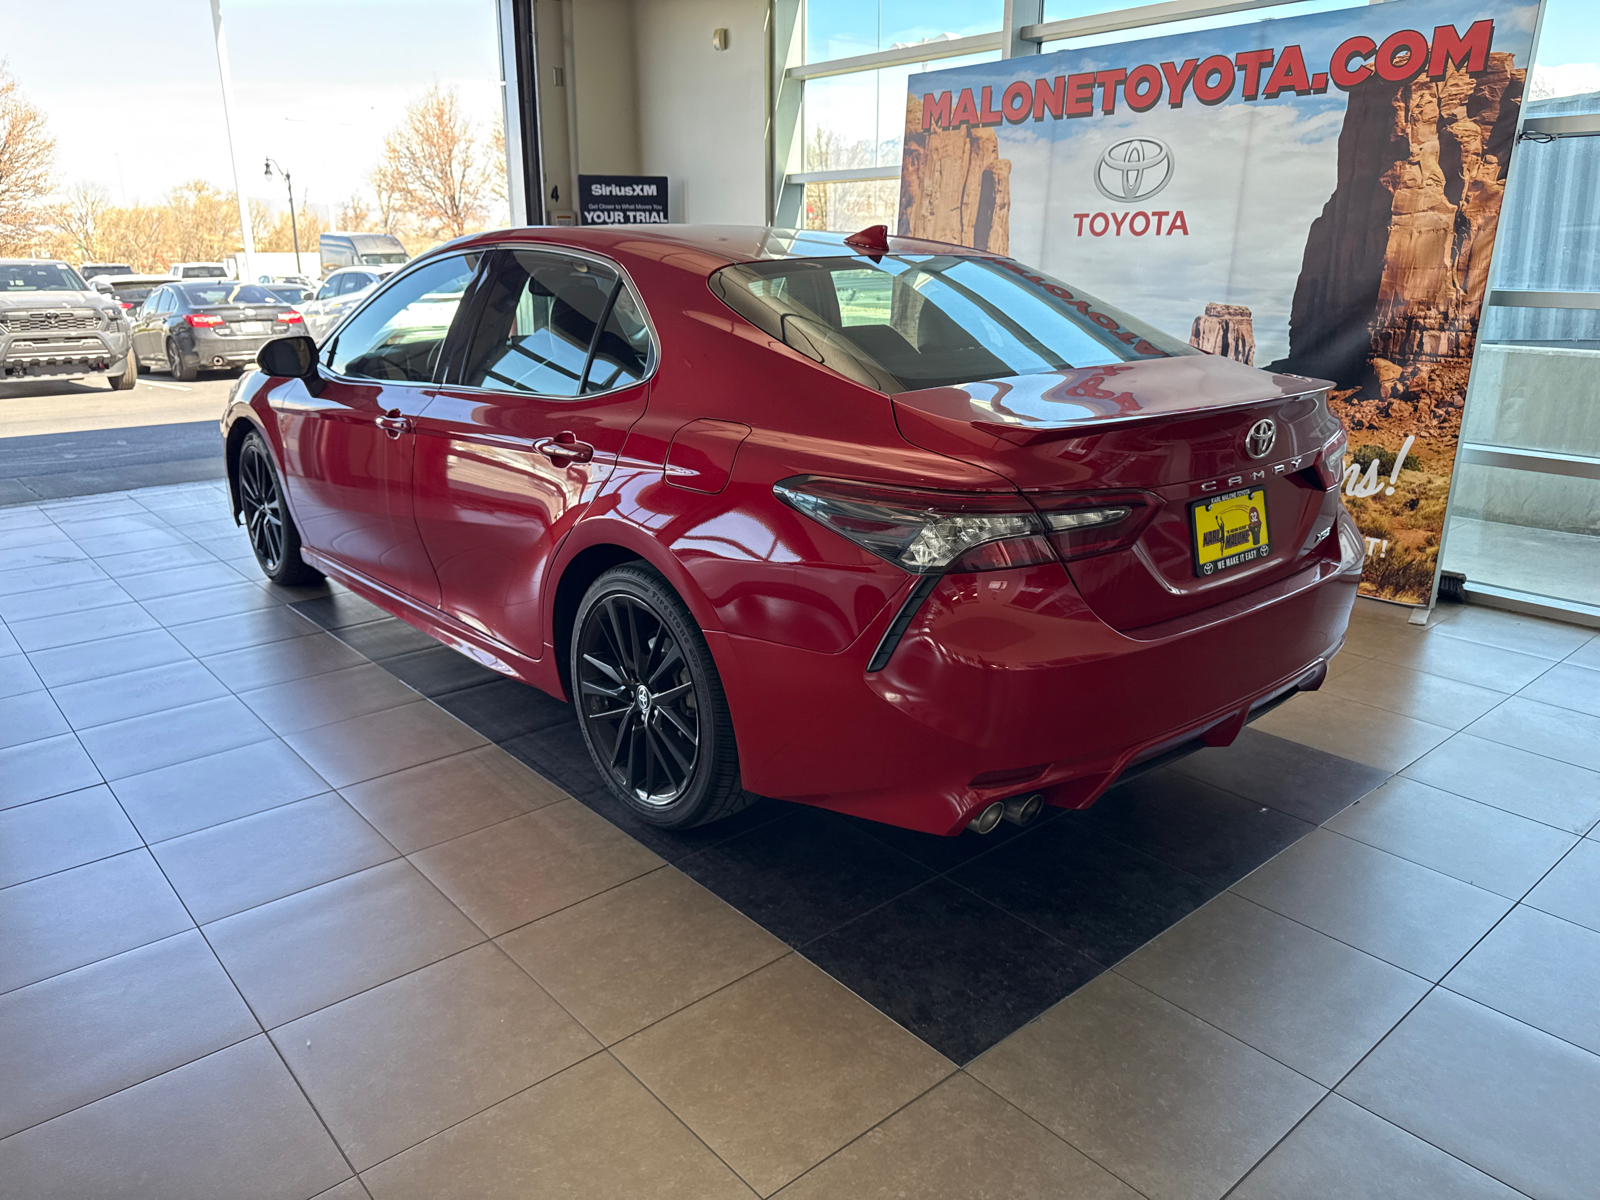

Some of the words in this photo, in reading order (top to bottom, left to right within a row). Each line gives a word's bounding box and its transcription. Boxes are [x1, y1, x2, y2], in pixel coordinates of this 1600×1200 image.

[922, 18, 1494, 133] MALONETOYOTA.COM
[550, 184, 560, 202] 4
[591, 183, 657, 197] SiriusXM
[583, 211, 625, 223] YOUR
[626, 211, 668, 223] TRIAL
[1073, 211, 1189, 237] TOYOTA
[1201, 458, 1302, 491] CAMRY
[1250, 511, 1258, 522] 32
[1217, 561, 1225, 570] WE
[1226, 557, 1239, 567] MAKE
[1239, 555, 1245, 563] IT
[1245, 550, 1257, 560] EASY
[650, 590, 690, 645] Firestone
